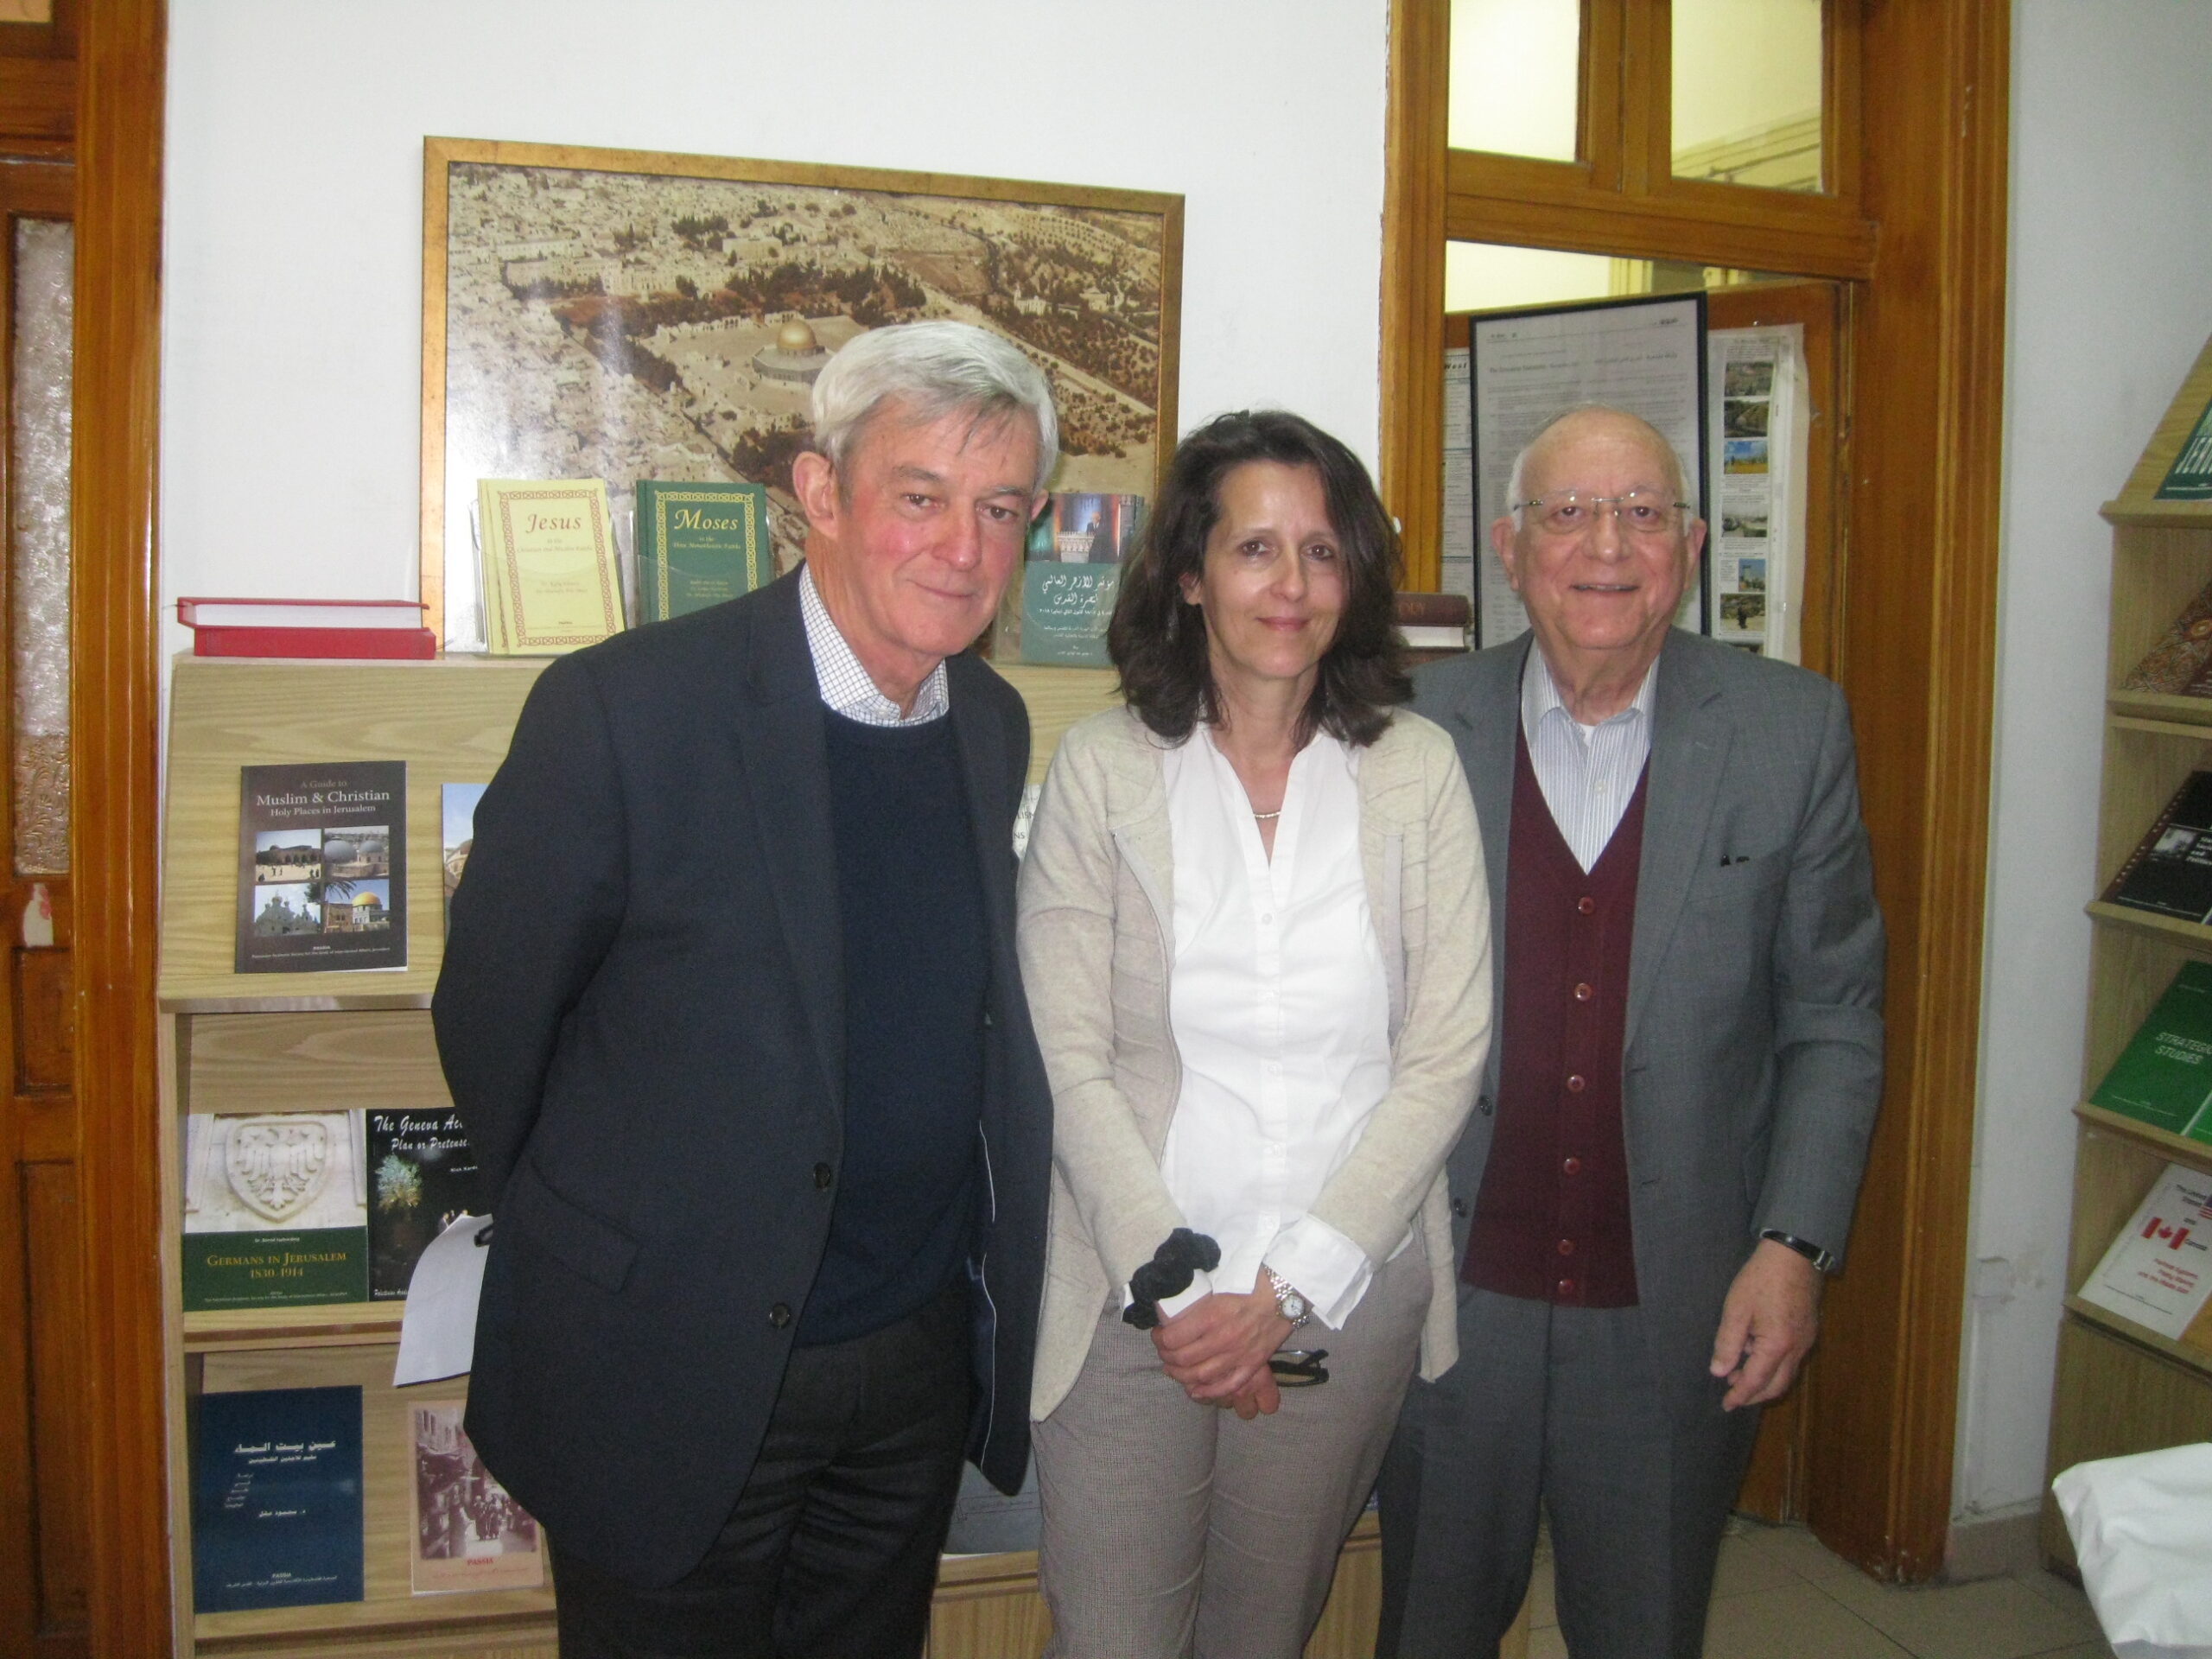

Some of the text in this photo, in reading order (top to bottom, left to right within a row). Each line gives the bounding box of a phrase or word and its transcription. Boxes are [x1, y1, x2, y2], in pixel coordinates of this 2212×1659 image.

[525, 513, 582, 534] Jesus
[674, 508, 739, 531] Moses
[1042, 574, 1067, 594] العالمي
[309, 780, 336, 789] Guide
[257, 790, 391, 806] Muslim & Christian
[270, 808, 292, 818] Holy
[294, 806, 321, 816] Places
[334, 804, 377, 814] Jerusalem
[374, 1116, 395, 1132] The
[400, 1116, 438, 1136] Geneva
[391, 1138, 413, 1151] Plan
[417, 1141, 426, 1150] or
